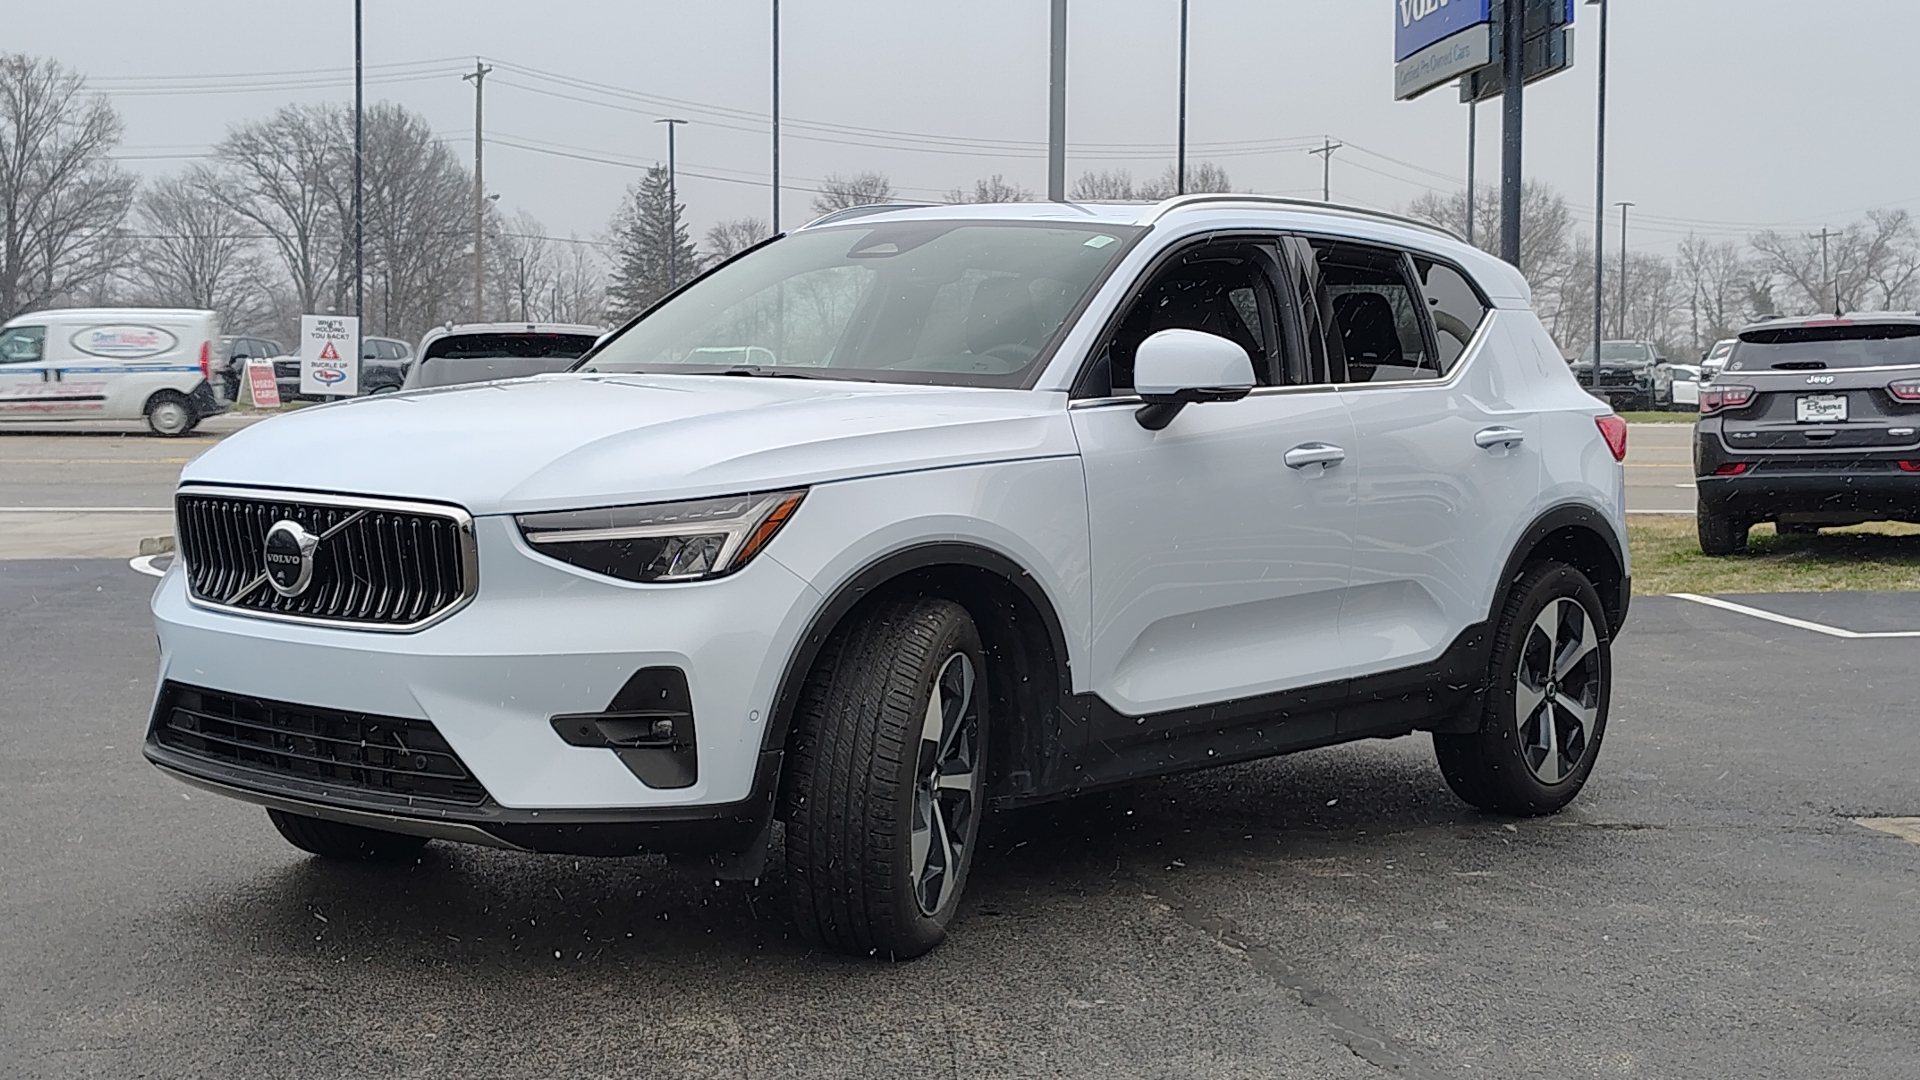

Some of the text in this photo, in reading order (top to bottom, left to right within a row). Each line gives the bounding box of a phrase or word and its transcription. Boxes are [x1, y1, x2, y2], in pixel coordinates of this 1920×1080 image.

[1400, 0, 1461, 27] VOL
[1453, 44, 1470, 61] Cars
[1806, 375, 1835, 385] Jeep
[267, 553, 301, 565] VOLVO
